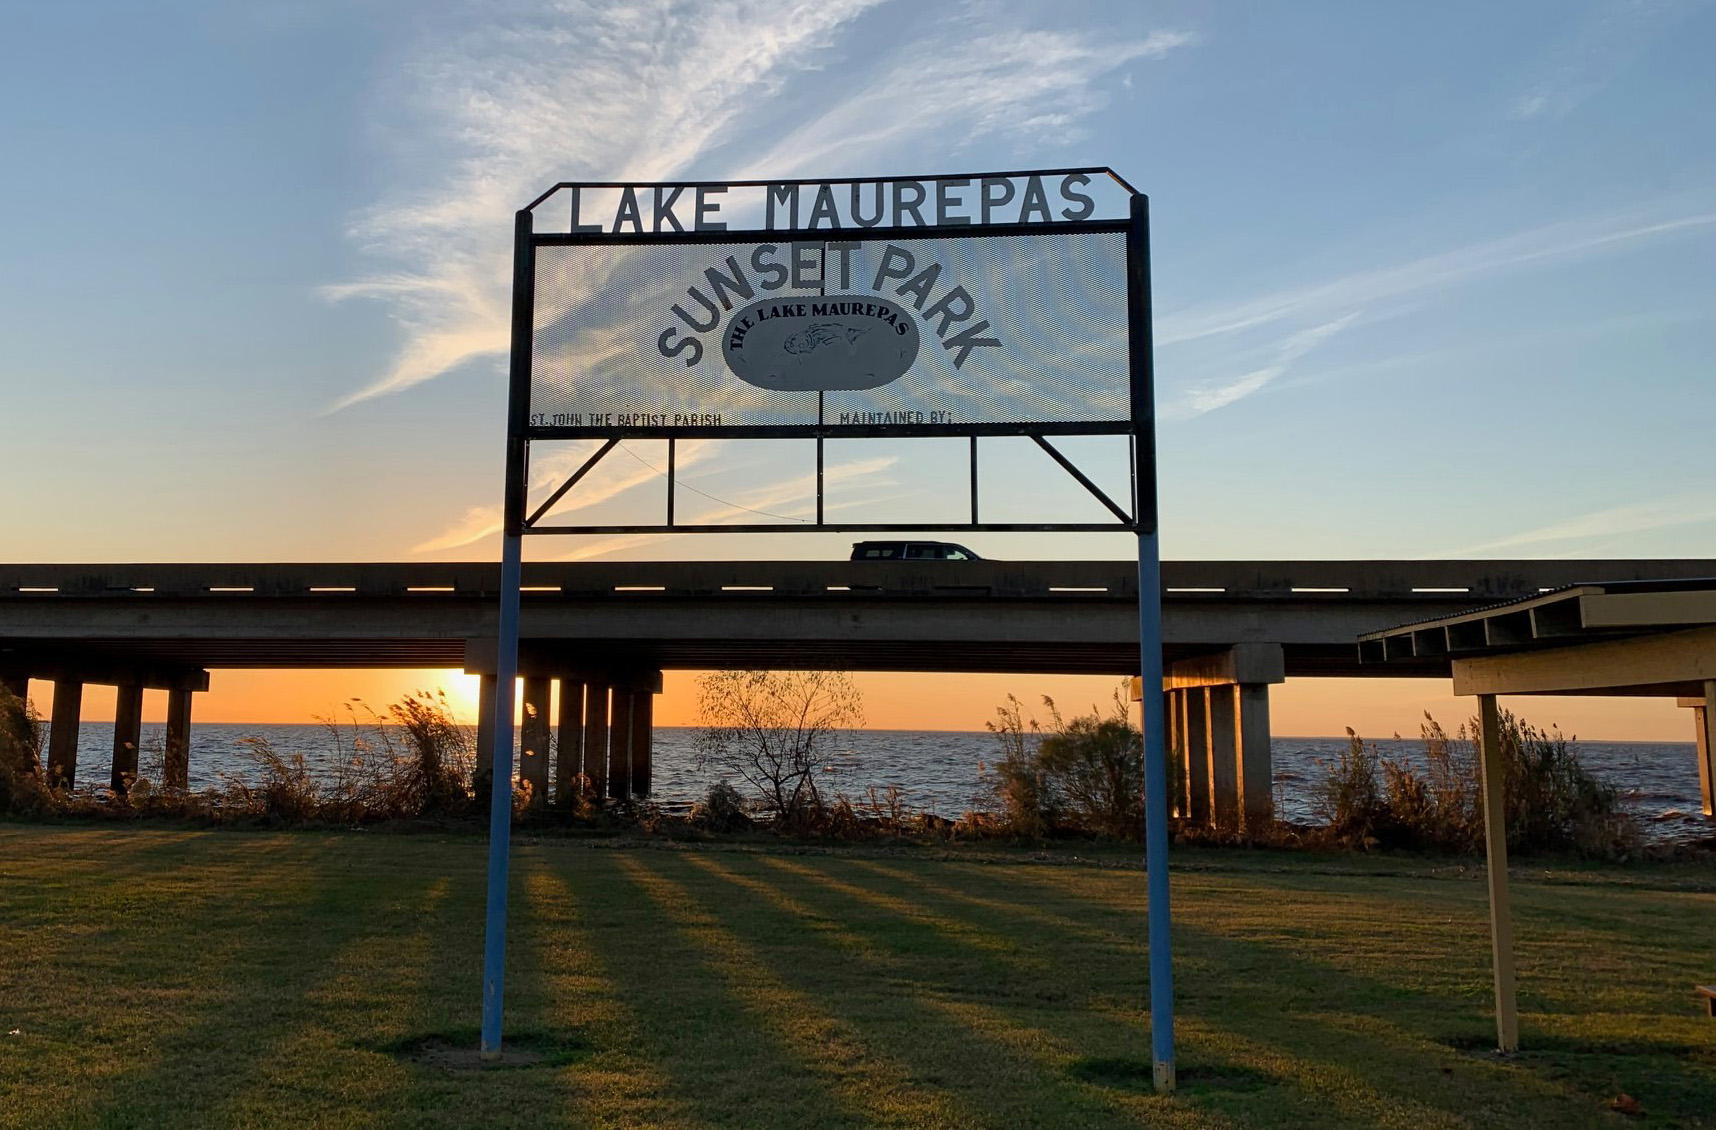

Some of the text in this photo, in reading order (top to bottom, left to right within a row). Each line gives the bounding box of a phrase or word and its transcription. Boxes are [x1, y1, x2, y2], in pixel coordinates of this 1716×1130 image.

[571, 173, 1095, 233] LAKE MAUREPAS
[658, 240, 1003, 370] SUNSET PARK
[729, 302, 910, 351] THE LAKE MAUREPAS
[589, 413, 612, 426] THE
[617, 413, 666, 427] BAPTIST
[674, 413, 722, 427] PARISH
[840, 411, 924, 425] MAINTAINED
